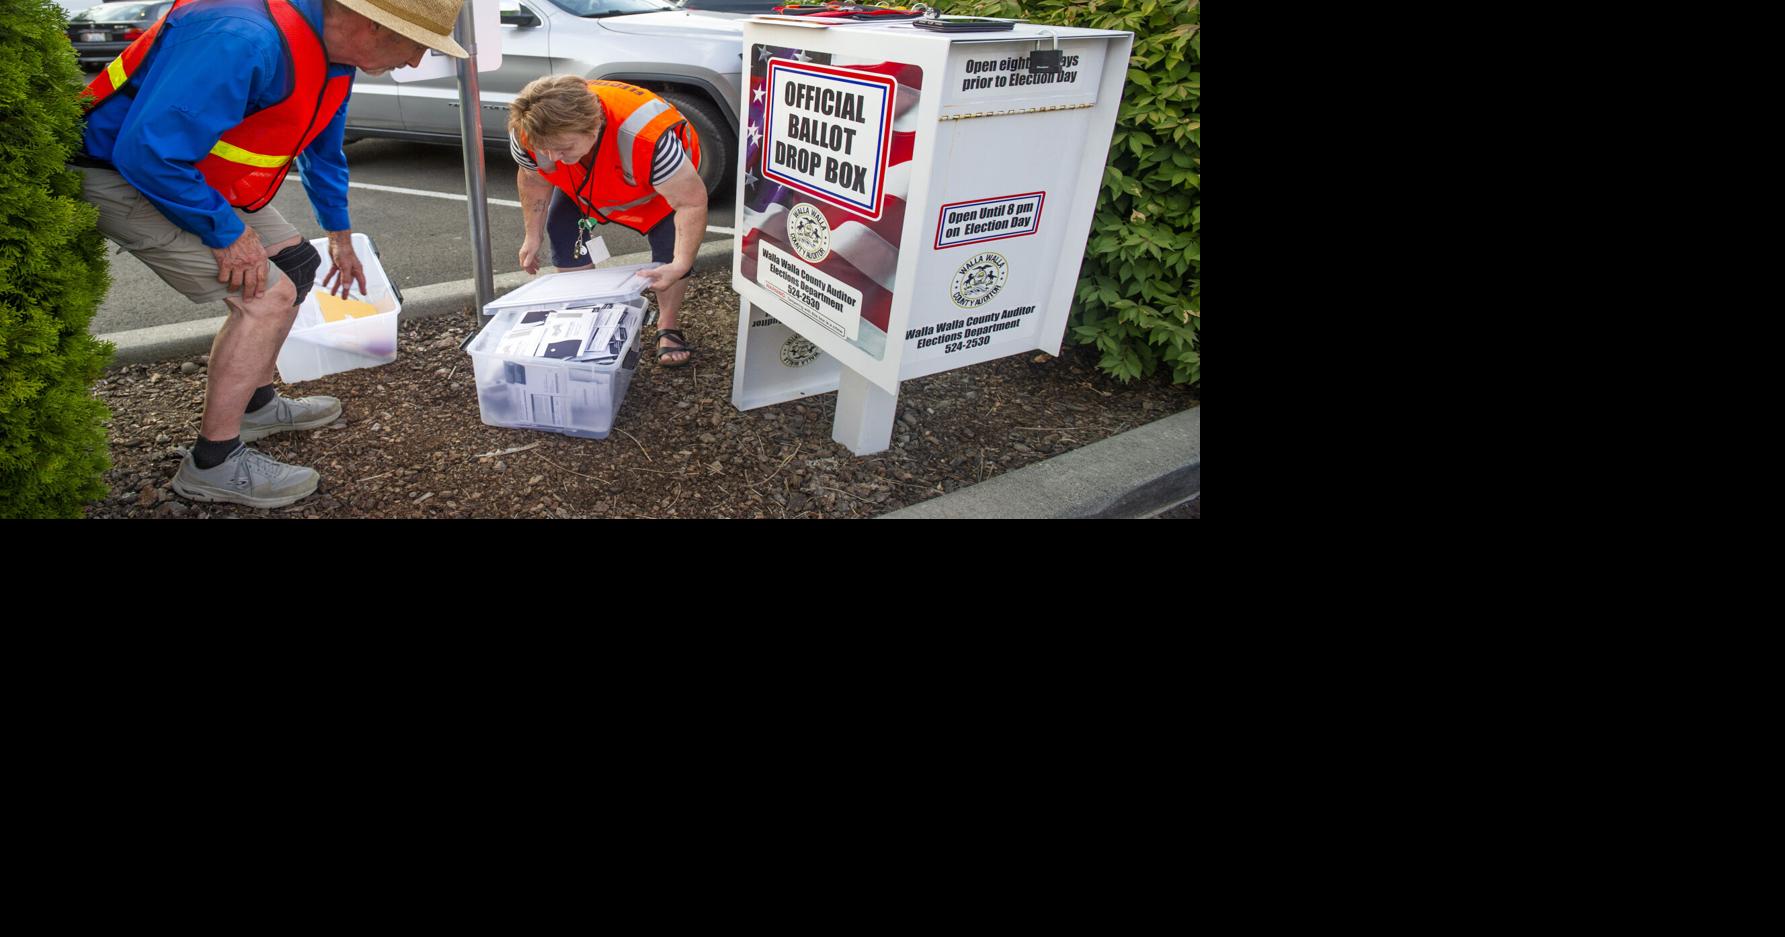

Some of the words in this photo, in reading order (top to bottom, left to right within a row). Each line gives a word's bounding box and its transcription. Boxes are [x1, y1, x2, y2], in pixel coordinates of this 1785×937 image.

[966, 59, 997, 74] Open
[1000, 57, 1030, 72] eight
[1060, 55, 1079, 66] ays
[962, 75, 993, 91] prior
[995, 75, 1007, 87] to
[1009, 72, 1054, 87] Election
[1056, 70, 1077, 83] Day
[784, 81, 865, 124] OFFICIAL
[788, 113, 857, 155] BALLOT
[774, 140, 821, 176] DROP
[825, 156, 867, 195] BOX
[793, 207, 809, 218] WALLA
[811, 209, 827, 231] WALLA
[948, 211, 977, 224] Open
[979, 204, 1006, 219] Until
[1007, 203, 1014, 215] 8
[1016, 203, 1034, 215] pm
[945, 227, 960, 238] on
[964, 219, 1009, 235] Election
[1010, 216, 1031, 228] Day
[959, 256, 984, 275] WALLA
[986, 254, 1005, 268] WALLA
[762, 247, 780, 265] Walla
[780, 258, 800, 276] Walla
[801, 269, 826, 291] County
[827, 284, 856, 307] Auditor
[770, 263, 799, 287] Elections
[800, 280, 844, 313] Department
[787, 284, 820, 311] 524-2530
[953, 291, 975, 306] COUNTY
[975, 285, 1001, 306] AUDITOR
[752, 318, 781, 327] uditor
[905, 326, 934, 340] Walla
[936, 319, 964, 333] Walla
[966, 312, 1000, 327] County
[1001, 305, 1036, 319] Auditor
[917, 331, 963, 349] Elections
[964, 319, 1021, 338] Department
[944, 335, 990, 354] 524-2530
